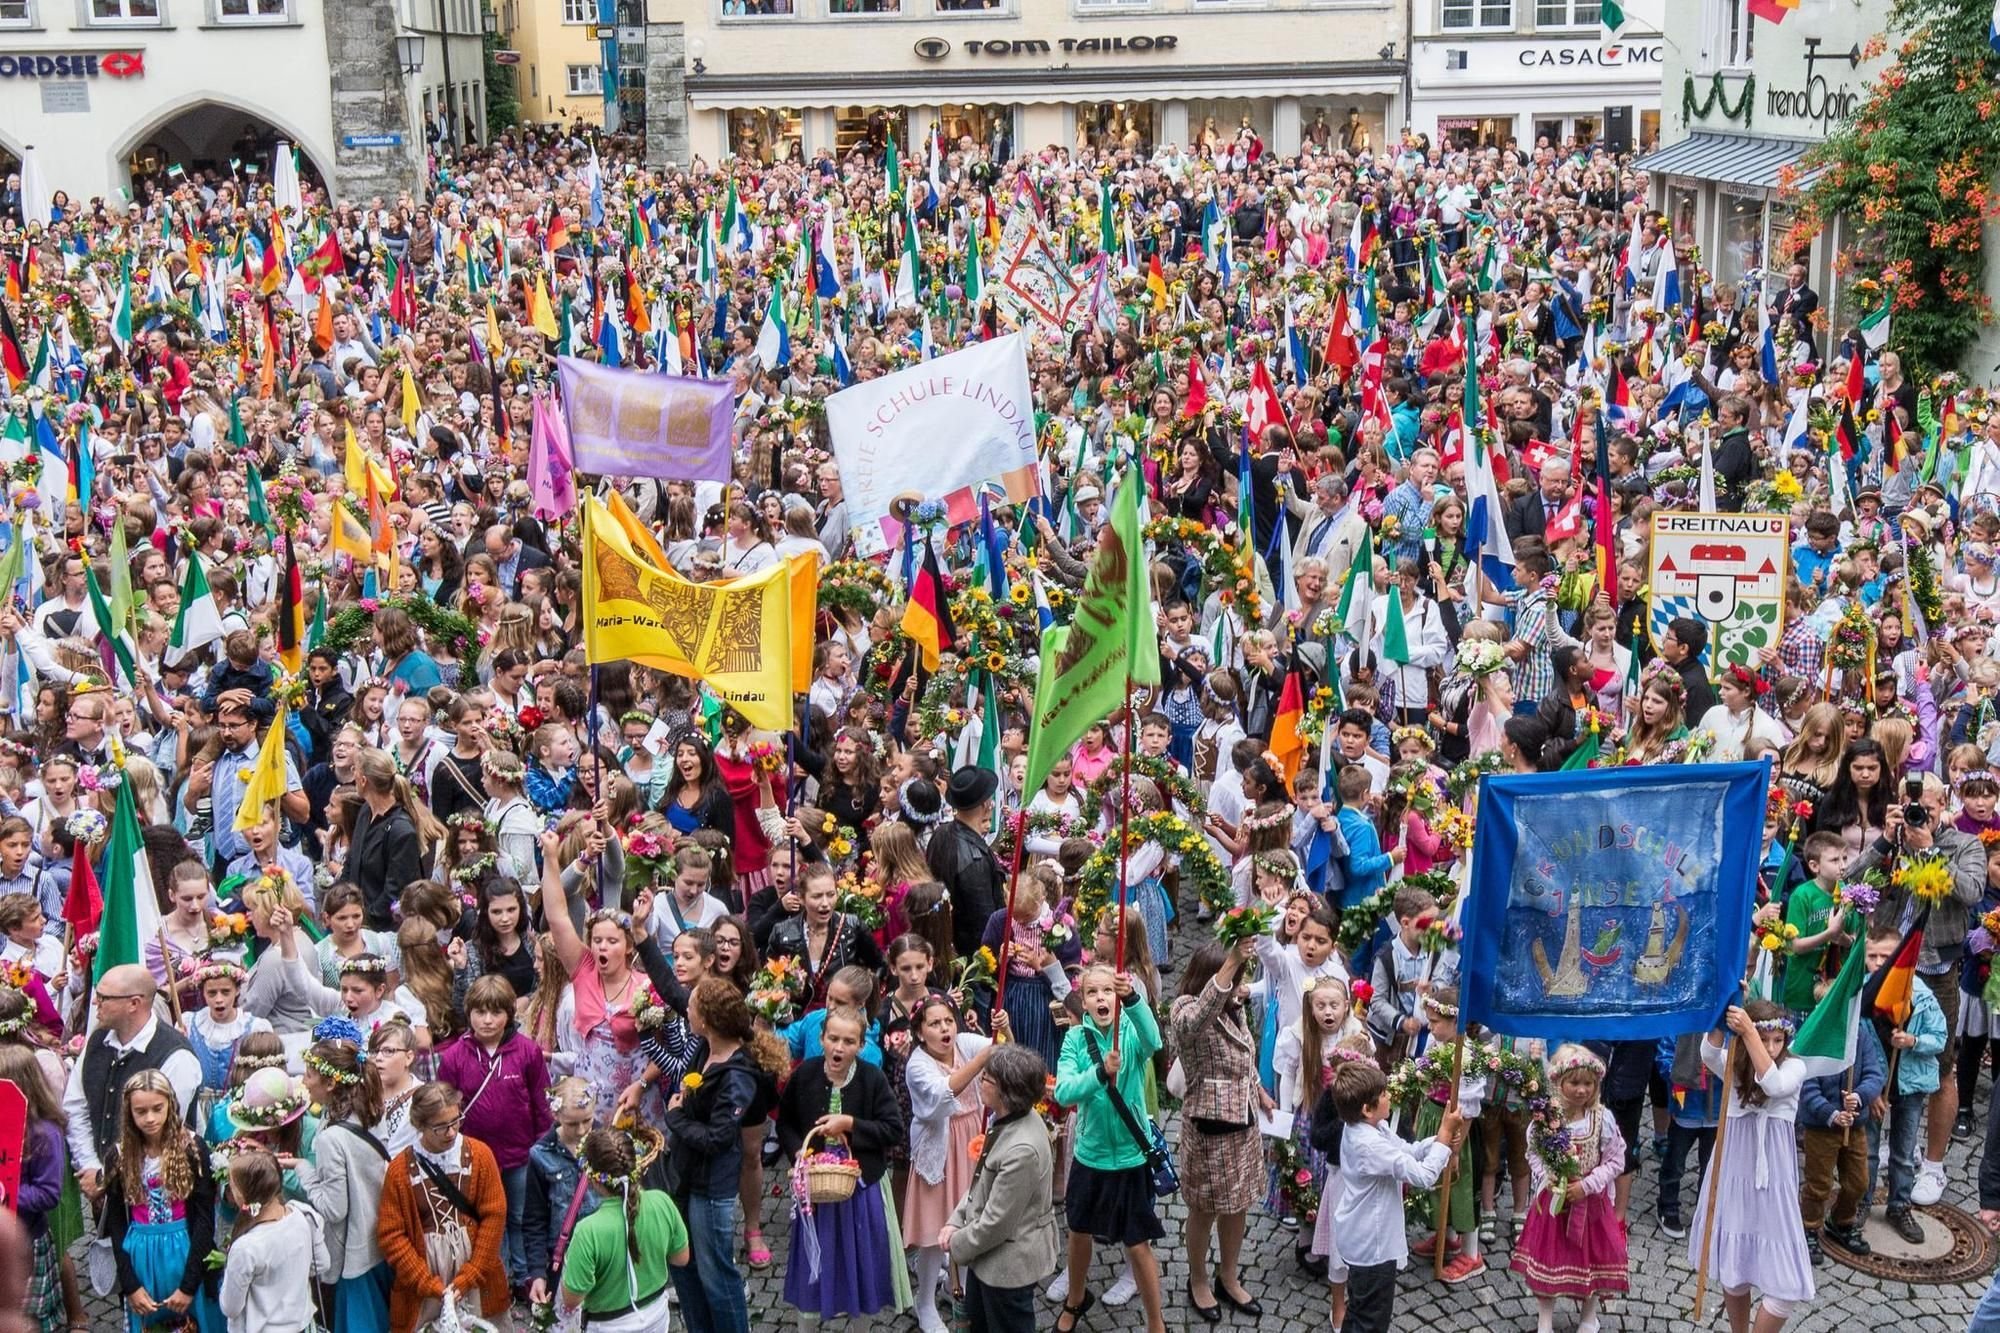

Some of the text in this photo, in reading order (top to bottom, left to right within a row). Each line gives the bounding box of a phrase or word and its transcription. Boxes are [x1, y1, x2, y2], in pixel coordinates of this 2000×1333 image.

[964, 35, 1178, 55] TOM TAILOR
[0, 55, 99, 77] ORDSEE
[1519, 46, 1663, 66] CASA MO
[867, 377, 953, 438] SCHULE
[962, 378, 1034, 451] LINDAU
[1671, 518, 1768, 533] REITNAU
[723, 690, 766, 702] Lindau
